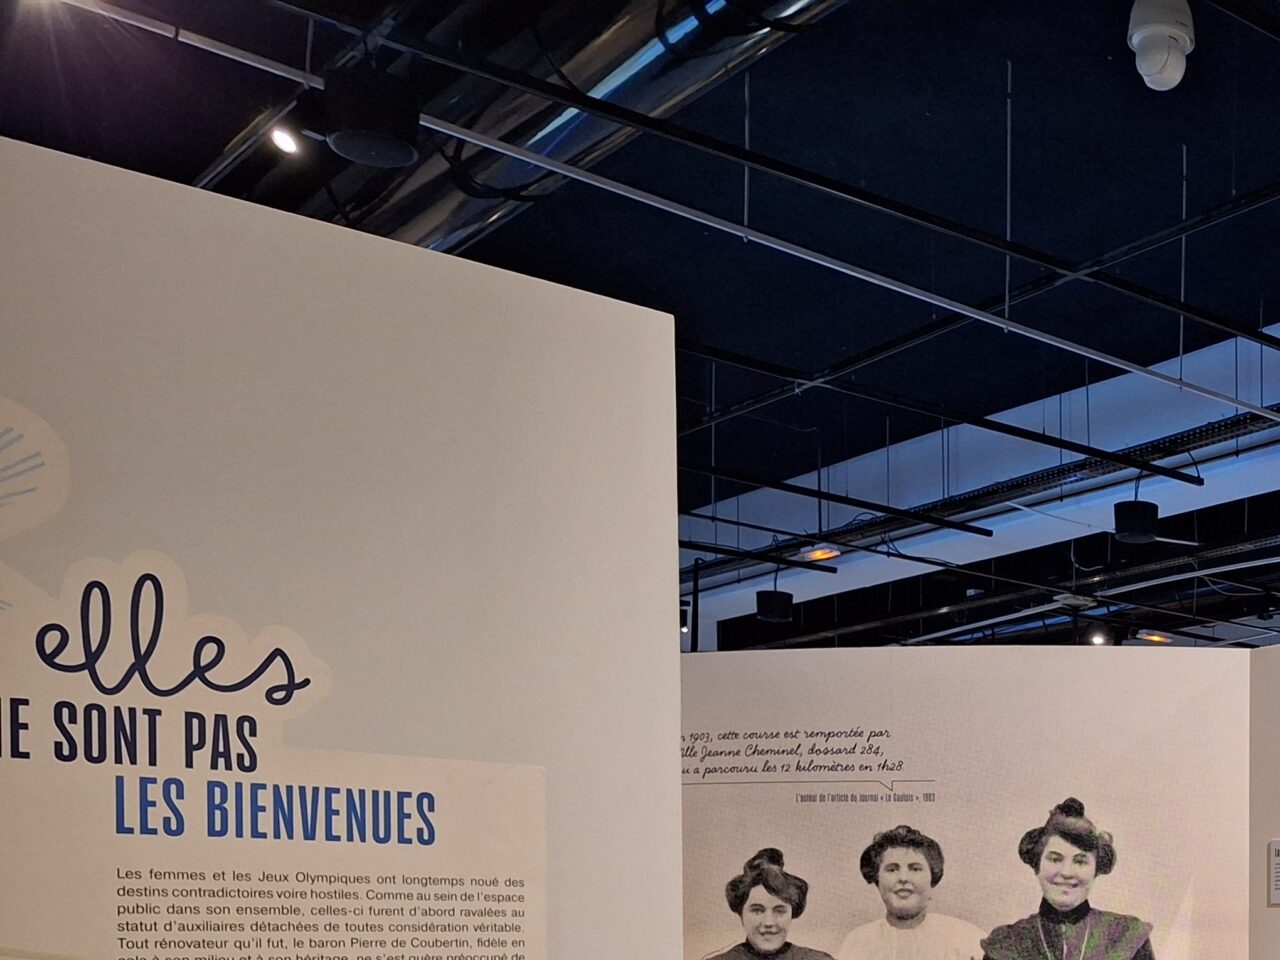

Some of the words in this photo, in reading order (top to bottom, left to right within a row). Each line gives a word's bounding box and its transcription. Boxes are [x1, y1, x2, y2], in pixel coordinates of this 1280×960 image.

[35, 572, 311, 706] elles
[0, 697, 30, 759] E
[54, 701, 162, 767] SONT
[185, 712, 258, 773] PAS
[743, 731, 780, 740] course
[784, 729, 802, 739] est
[804, 726, 864, 743] remportée
[867, 729, 891, 743] par
[700, 745, 741, 763] Jeanne
[807, 743, 857, 756] dossard
[860, 744, 884, 757] 284,
[702, 766, 758, 779] parcouru
[761, 759, 776, 773] les
[780, 764, 791, 772] 12
[795, 759, 855, 773] kilomètres
[859, 764, 873, 772] en
[877, 758, 904, 772] 1h28
[115, 775, 185, 837] LES
[207, 780, 436, 846] BIENVENUES
[116, 866, 142, 880] Les
[148, 867, 206, 881] femmes
[212, 868, 226, 881] et
[232, 869, 252, 882] les
[257, 869, 289, 882] Jeux
[295, 870, 370, 887] Olympiques
[376, 872, 396, 884] ont
[402, 872, 464, 889] longtemps
[470, 875, 499, 886] noué
[504, 875, 524, 887] des
[116, 884, 168, 897] destins
[171, 885, 274, 898] contradictoires
[275, 886, 307, 899] voire
[310, 886, 362, 900] hostiles.
[365, 887, 414, 900] Comme
[416, 891, 430, 901] au
[433, 889, 457, 901] sein
[459, 889, 474, 902] de
[476, 890, 524, 906] l'espace
[116, 901, 160, 918] public
[166, 901, 200, 915] dans
[205, 905, 230, 915] son
[235, 902, 304, 918] ensemble,
[310, 903, 363, 916] celles-ci
[368, 903, 404, 916] furent
[408, 904, 455, 917] d'abord
[459, 905, 507, 917] ravalées
[510, 908, 524, 917] au
[116, 919, 158, 932] statut
[163, 919, 245, 932] d'auxiliaires
[249, 919, 319, 932] détachées
[323, 920, 340, 932] de
[344, 920, 384, 932] toutes
[388, 920, 468, 932] considération
[472, 920, 524, 932] véritable.
[116, 936, 149, 949] Tout
[154, 936, 228, 949] rénovateur
[233, 936, 262, 952] qu'il
[266, 936, 288, 951] fut,
[292, 936, 304, 949] le
[308, 936, 346, 948] baron
[350, 936, 386, 948] Pierre
[390, 936, 406, 948] de
[410, 936, 472, 950] Coubertin,
[476, 936, 507, 948] fidèle
[511, 938, 525, 948] en
